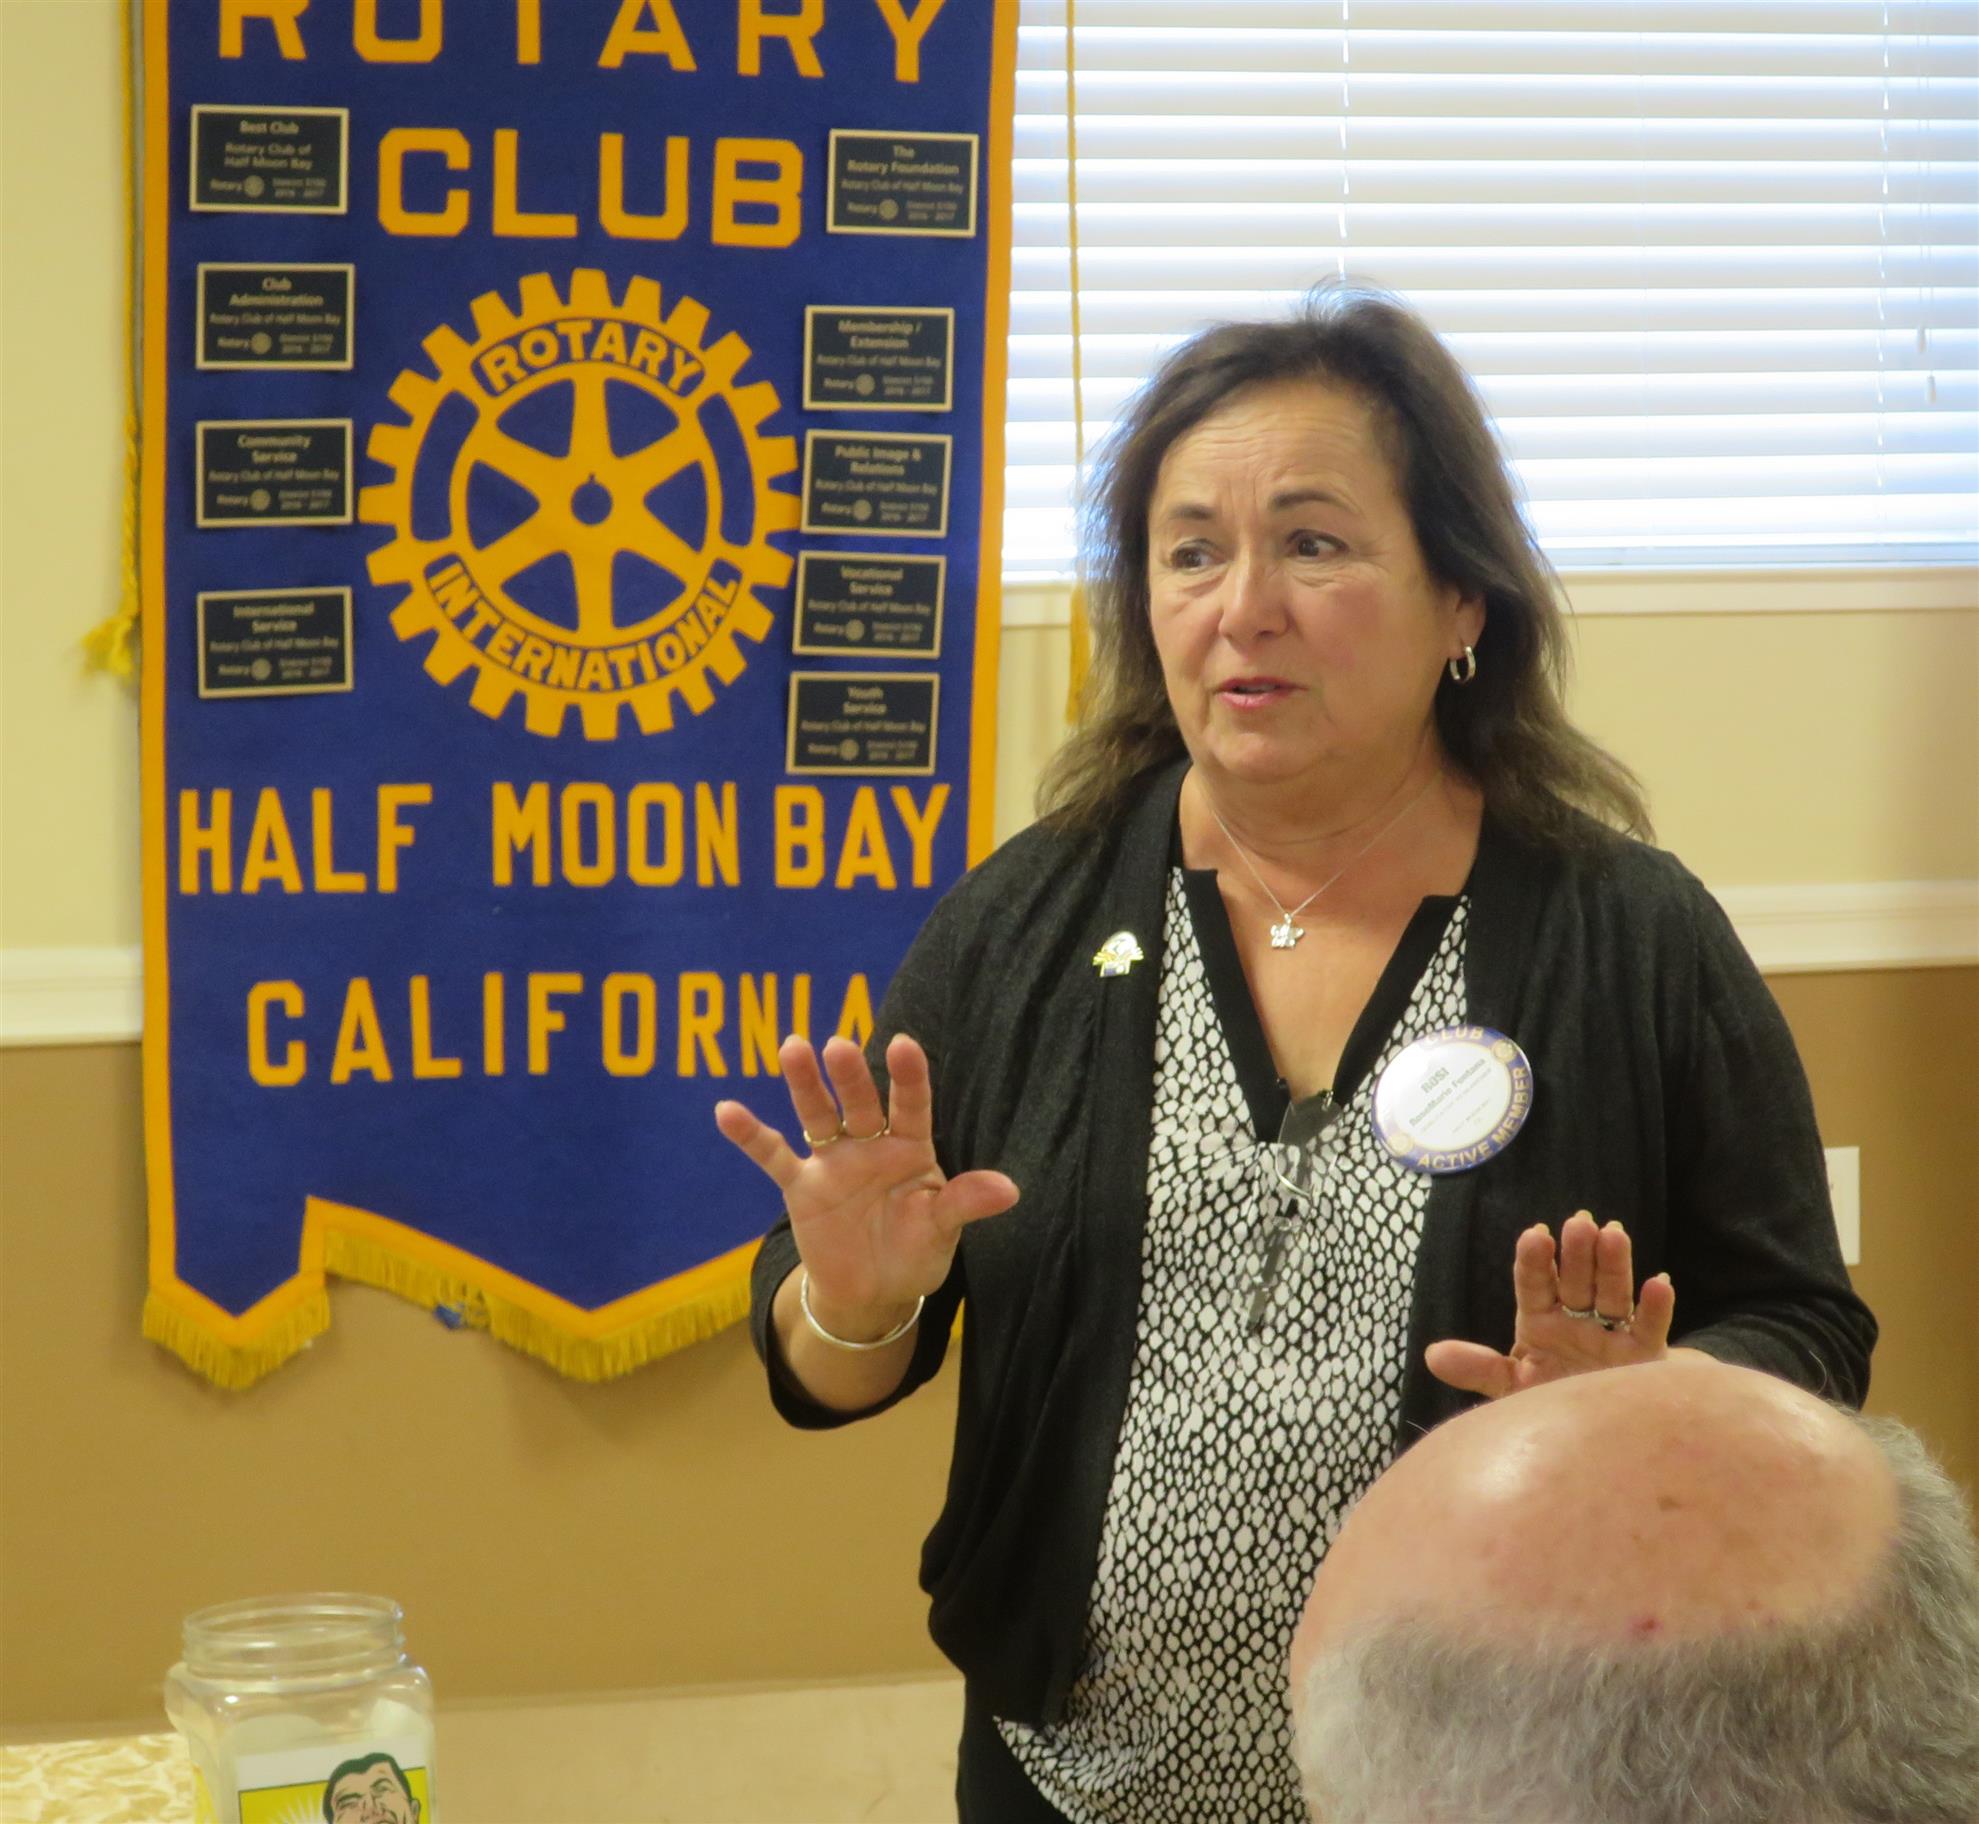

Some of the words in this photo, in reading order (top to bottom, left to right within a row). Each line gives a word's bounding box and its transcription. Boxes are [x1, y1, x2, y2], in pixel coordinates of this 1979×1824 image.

[240, 121, 268, 135] Best
[269, 121, 300, 135] Club
[893, 145, 915, 158] The
[847, 160, 889, 175] Rotary
[891, 162, 960, 175] Foundation
[378, 128, 803, 248] CLUB
[262, 277, 292, 291] Club
[229, 294, 325, 307] Administration
[479, 319, 700, 396] ROTARY
[237, 434, 312, 449] Community
[252, 450, 298, 463] Service
[233, 602, 315, 619] International
[252, 620, 298, 634] Service
[428, 560, 739, 690] INTERNATIONAL
[178, 784, 433, 894] HALF
[491, 781, 740, 889] MOON
[774, 783, 951, 890] BAY
[247, 972, 874, 1087] CALIFORNIA
[1427, 1026, 1485, 1044] CLUB
[1417, 1141, 1493, 1169] ACTIVE
[1491, 1066, 1530, 1146] MEMBER
